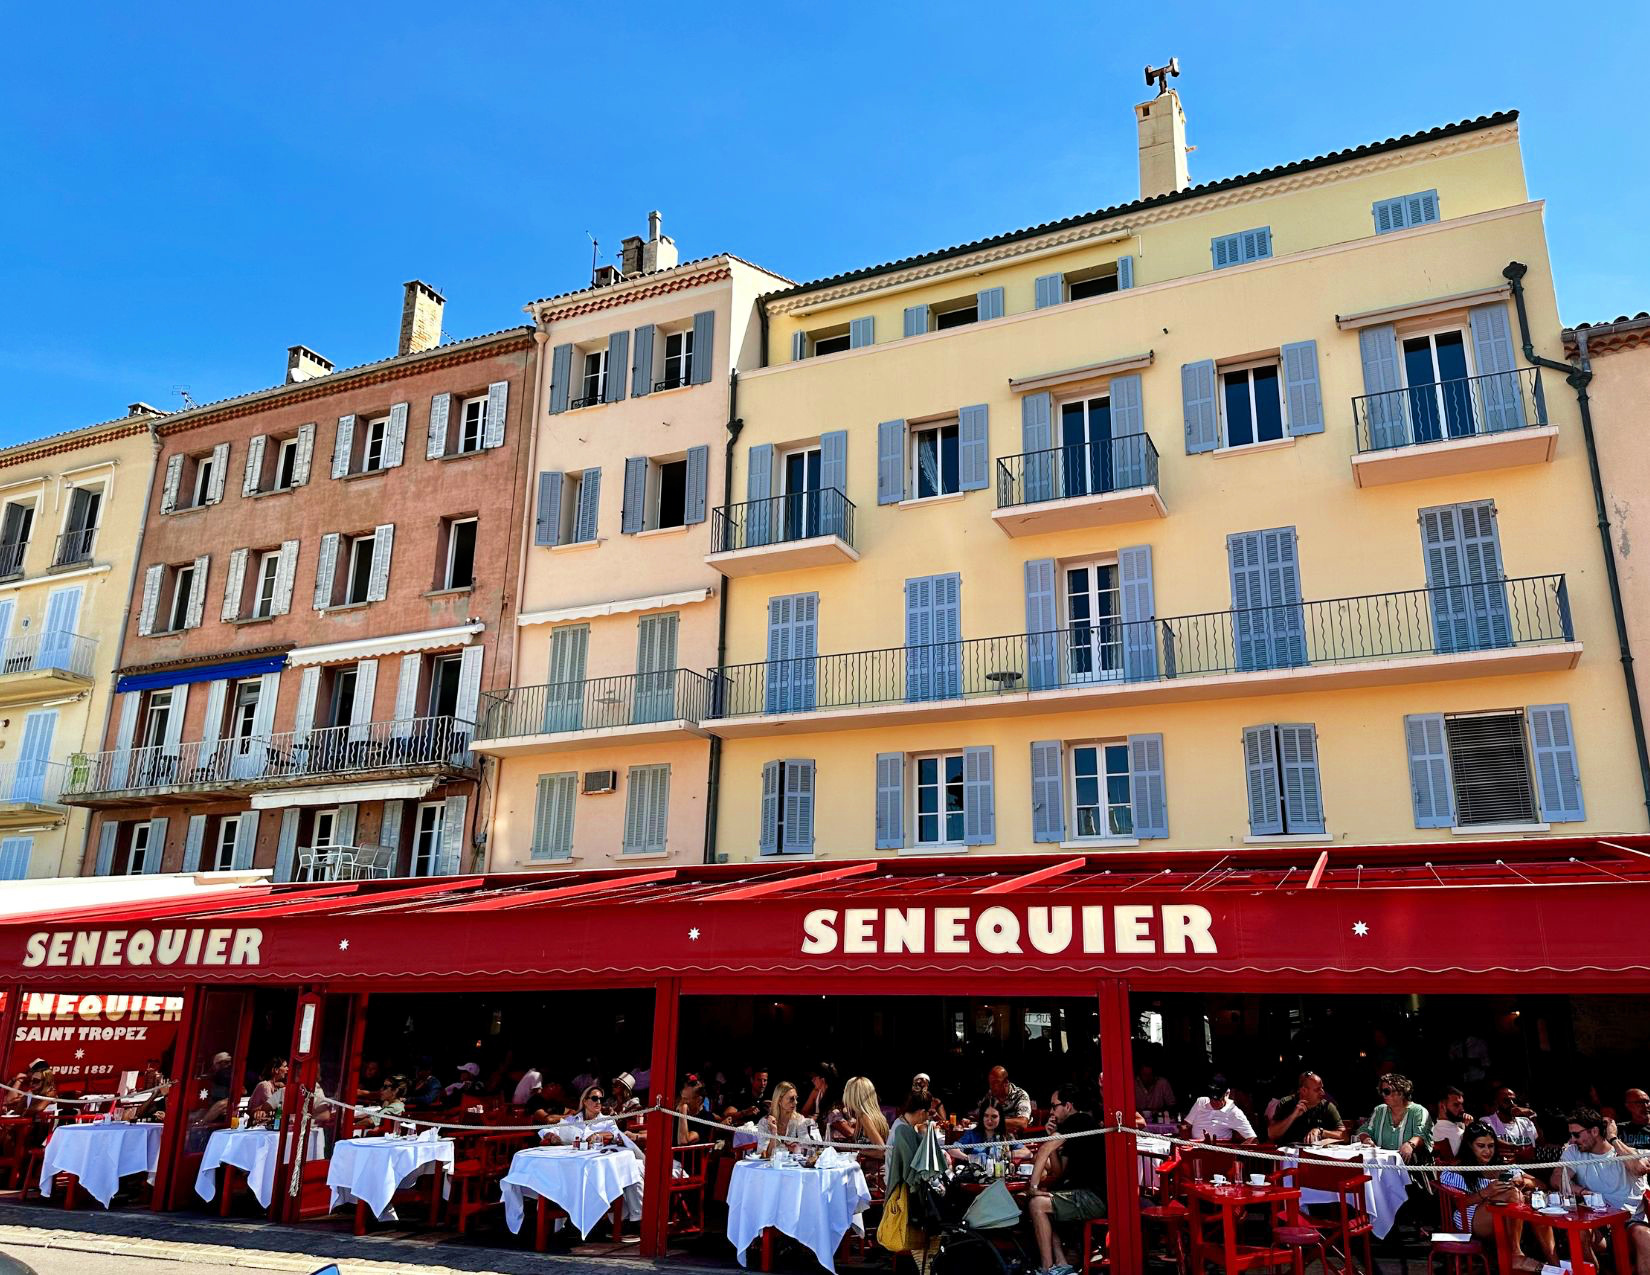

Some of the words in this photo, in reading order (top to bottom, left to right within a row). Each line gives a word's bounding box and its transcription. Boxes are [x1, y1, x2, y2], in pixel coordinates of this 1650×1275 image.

[802, 905, 1218, 954] SENEQUIER
[22, 928, 263, 967] SENEQUIER
[19, 992, 184, 1021] NEQUIER
[15, 1026, 76, 1041] SAINT
[78, 1026, 148, 1041] TROPEZ
[49, 1065, 80, 1075] PUIS
[84, 1064, 114, 1075] 1887
